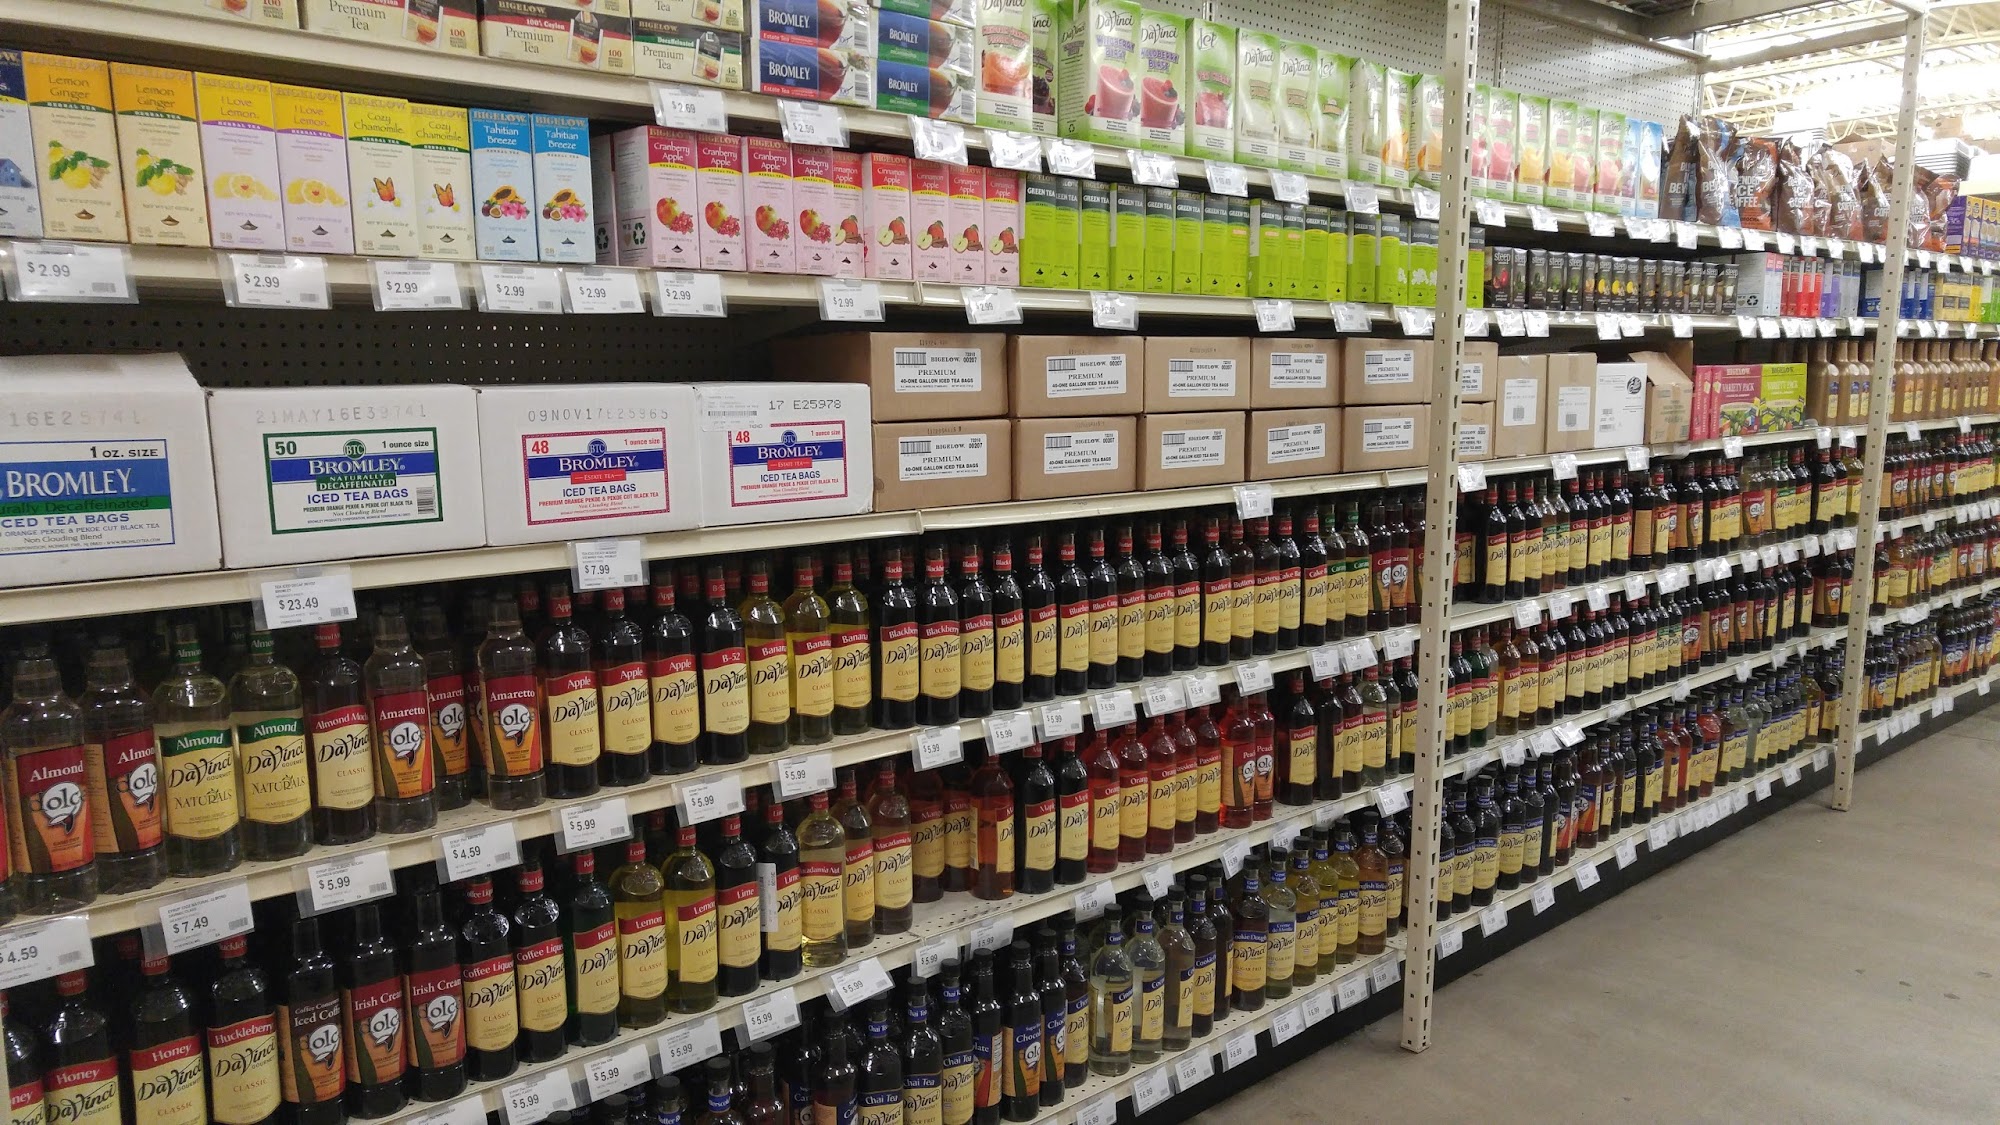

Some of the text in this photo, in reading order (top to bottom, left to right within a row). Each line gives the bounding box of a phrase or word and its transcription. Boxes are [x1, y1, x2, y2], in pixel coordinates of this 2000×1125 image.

[499, 2, 547, 14] BIGELOW
[348, 15, 370, 31] Tea
[544, 21, 565, 30] Ceylon
[768, 10, 810, 28] BROMLEY
[450, 29, 465, 37] 100
[505, 26, 554, 43] Premium
[889, 28, 918, 43] BROMLEY
[521, 41, 539, 54] Tea
[608, 50, 622, 58] 100
[642, 46, 684, 60] Premium
[656, 59, 671, 71] Tea
[727, 67, 736, 75] 48
[768, 61, 810, 81] BROMLEY
[48, 74, 90, 88] Lemon
[888, 78, 918, 92] BROMLEY
[50, 87, 90, 101] Ginger
[135, 84, 175, 96] Lemon
[137, 97, 175, 110] Ginger
[367, 112, 391, 125] Cozy
[428, 121, 451, 133] Cozy
[484, 124, 519, 136] Tahitian
[487, 135, 517, 146] Breeze
[545, 128, 579, 141] Tahitian
[548, 139, 577, 150] Breeze
[653, 142, 690, 155] Cranberry
[662, 152, 684, 163] Apple
[703, 147, 738, 161] Cranberry
[753, 152, 787, 165] Cranberry
[711, 157, 731, 169] Apple
[761, 162, 781, 173] Apple
[797, 157, 829, 170] Cranberry
[804, 166, 824, 177] Apple
[878, 167, 905, 177] Cinnamon
[883, 175, 901, 186] Apple
[953, 176, 980, 186] Cinnamon
[959, 185, 975, 195] Apple
[1027, 187, 1056, 198] GREEN TEA
[1494, 252, 1511, 263] steep
[1549, 257, 1564, 267] steep
[1569, 258, 1583, 268] steep
[769, 399, 842, 411] 17 E25978
[90, 447, 158, 458] 1 OZ. SIZE
[275, 441, 297, 455] 50
[345, 444, 364, 456] BTC
[389, 441, 412, 449] ounce
[414, 439, 429, 447] size
[922, 456, 962, 464] PREMIUM
[329, 473, 385, 482] NATURALLY
[760, 471, 821, 483] ICED TEA BAGS
[319, 478, 395, 490] DECAFFEINATED
[563, 483, 636, 497] ICED TEA BAGS
[308, 488, 409, 504] ICED TEA BAGS
[45, 498, 149, 513] Decaffeinated
[0, 513, 130, 528] CED TEA BAGS
[5, 529, 38, 537] ORANGE
[120, 523, 144, 531] BLACK
[42, 534, 79, 544] Clouding
[80, 533, 103, 541] Blend
[926, 624, 959, 637] Blackberry
[842, 633, 868, 643] Banana
[722, 652, 740, 663] B-52
[669, 659, 692, 672] Apple
[620, 667, 643, 680] Apple
[567, 676, 591, 689] Apple
[490, 689, 535, 703] Amaretto
[379, 706, 425, 721] Amaretto
[315, 713, 350, 730] Almond
[253, 721, 297, 738] Almond
[176, 734, 224, 751] Almond
[245, 739, 304, 774] DaVinci
[30, 761, 84, 782] Almond
[168, 751, 232, 788] DaVinci
[251, 775, 305, 795] NATURALS
[174, 788, 232, 810] NATURALS
[876, 836, 906, 849] Macadamia
[784, 873, 800, 884] Lime
[737, 888, 755, 899] Lime
[636, 916, 662, 928] Lemon
[598, 928, 613, 940] Kiwi
[517, 950, 543, 961] Coffee
[463, 966, 491, 979] Coffee
[412, 982, 434, 996] Irish
[355, 997, 378, 1011] Irish
[294, 1013, 316, 1027] Iced
[215, 1020, 273, 1045] Huckleberry
[152, 1044, 192, 1062] Honey
[215, 1036, 275, 1077] DaVinci
[944, 1055, 972, 1067] Chai Tea
[57, 1068, 99, 1085] Honey
[233, 1078, 268, 1093] CLASSIC
[865, 1095, 898, 1104] Chai Tea
